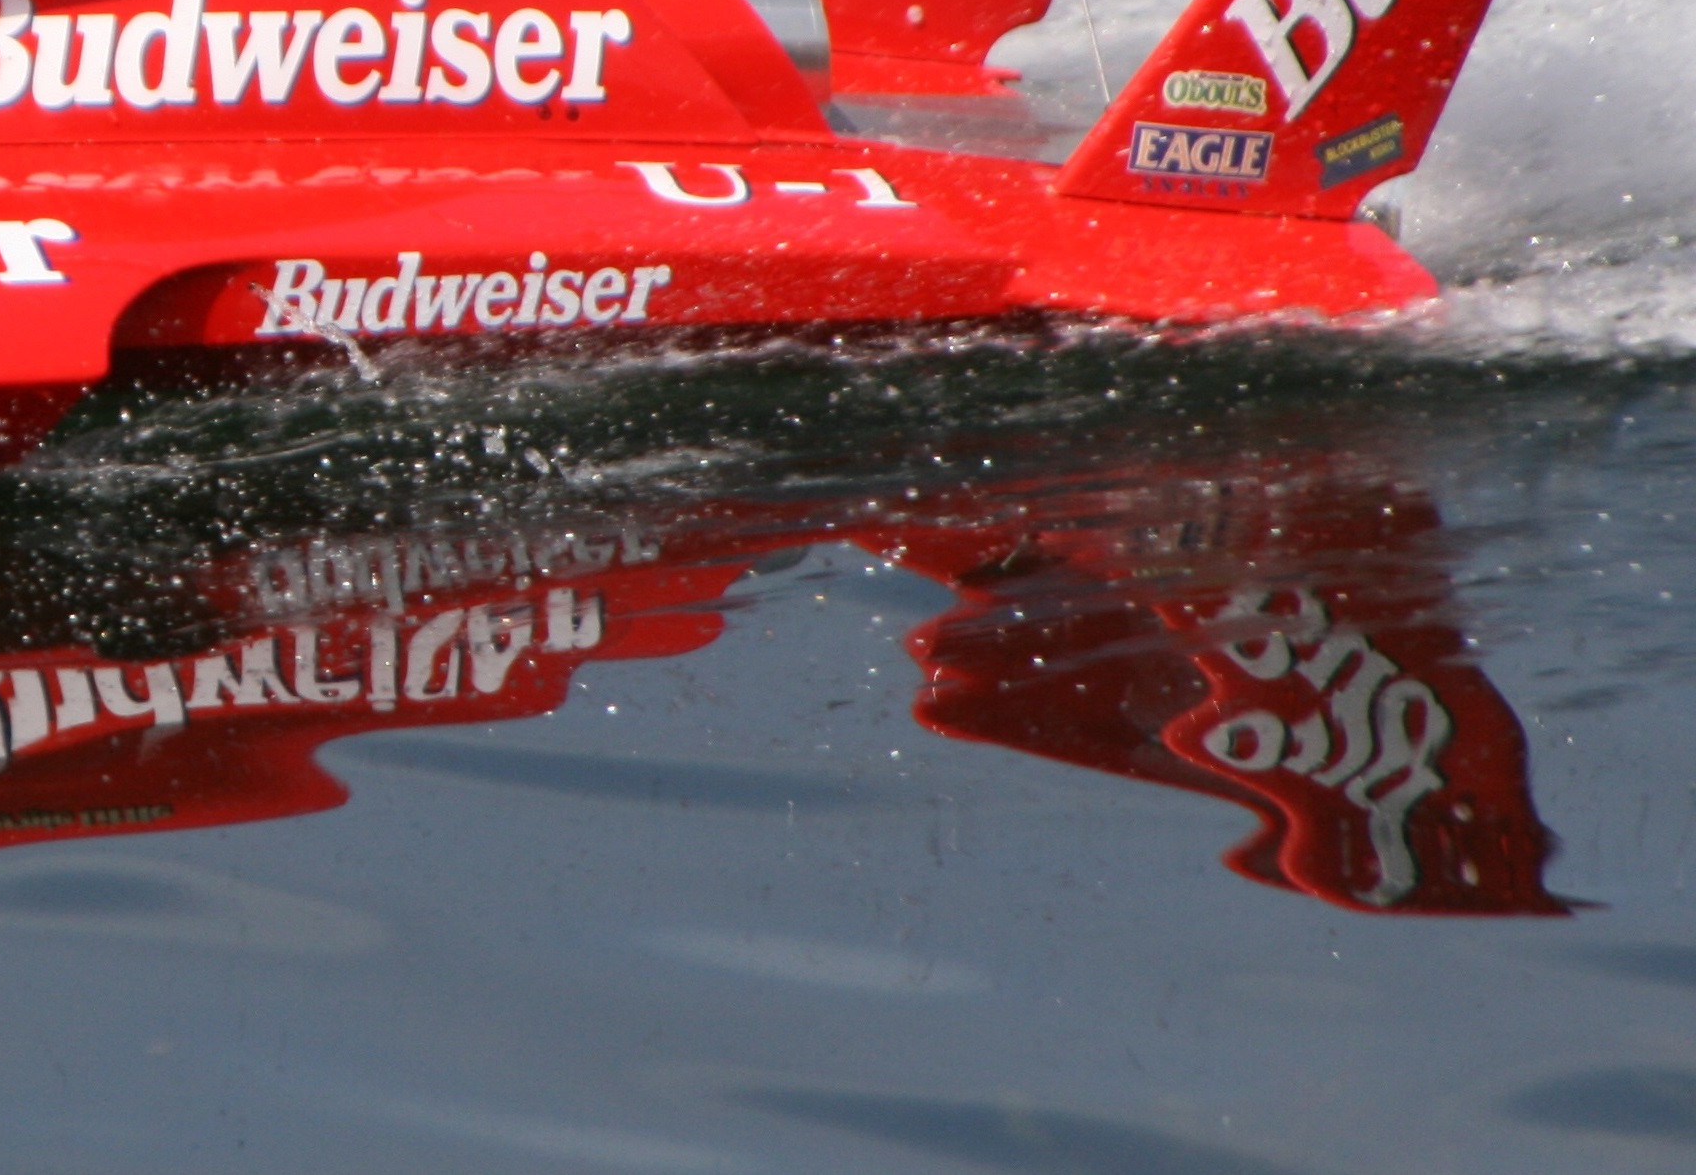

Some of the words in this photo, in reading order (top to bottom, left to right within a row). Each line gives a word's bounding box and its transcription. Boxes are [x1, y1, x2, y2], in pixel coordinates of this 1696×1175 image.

[1134, 128, 1265, 176] EAGLE
[614, 160, 919, 209] U-1
[255, 251, 671, 337] Budweiser
